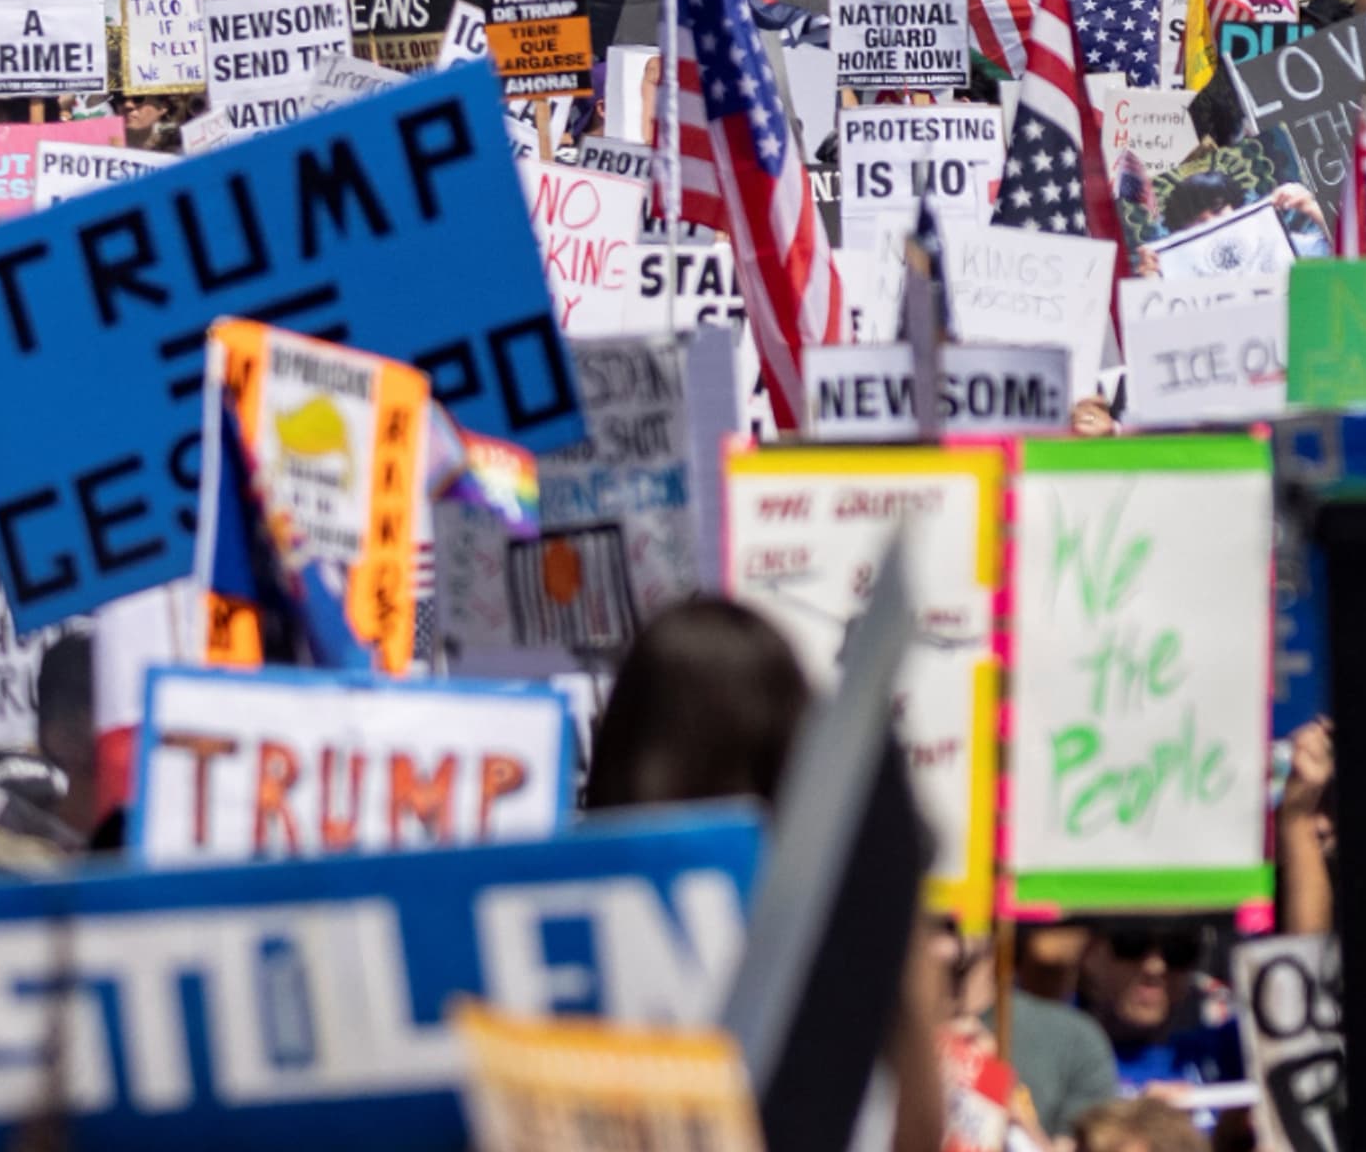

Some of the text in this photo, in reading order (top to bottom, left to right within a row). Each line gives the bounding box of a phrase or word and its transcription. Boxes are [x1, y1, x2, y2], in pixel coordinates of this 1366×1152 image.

[23, 10, 43, 37] A
[492, 1, 578, 22] DE TRUMP
[838, 3, 957, 28] NATIONAL
[209, 4, 343, 44] NEWSOM:
[510, 23, 559, 38] TIENE
[520, 40, 558, 55] QUE
[865, 26, 937, 49] GUARD
[213, 53, 293, 83] SEND
[837, 49, 962, 73] HOME NOW!
[506, 74, 578, 93] AHORA!
[845, 119, 996, 143] PROTESTING
[1047, 480, 1155, 622] We
[157, 730, 533, 854] TRUMP
